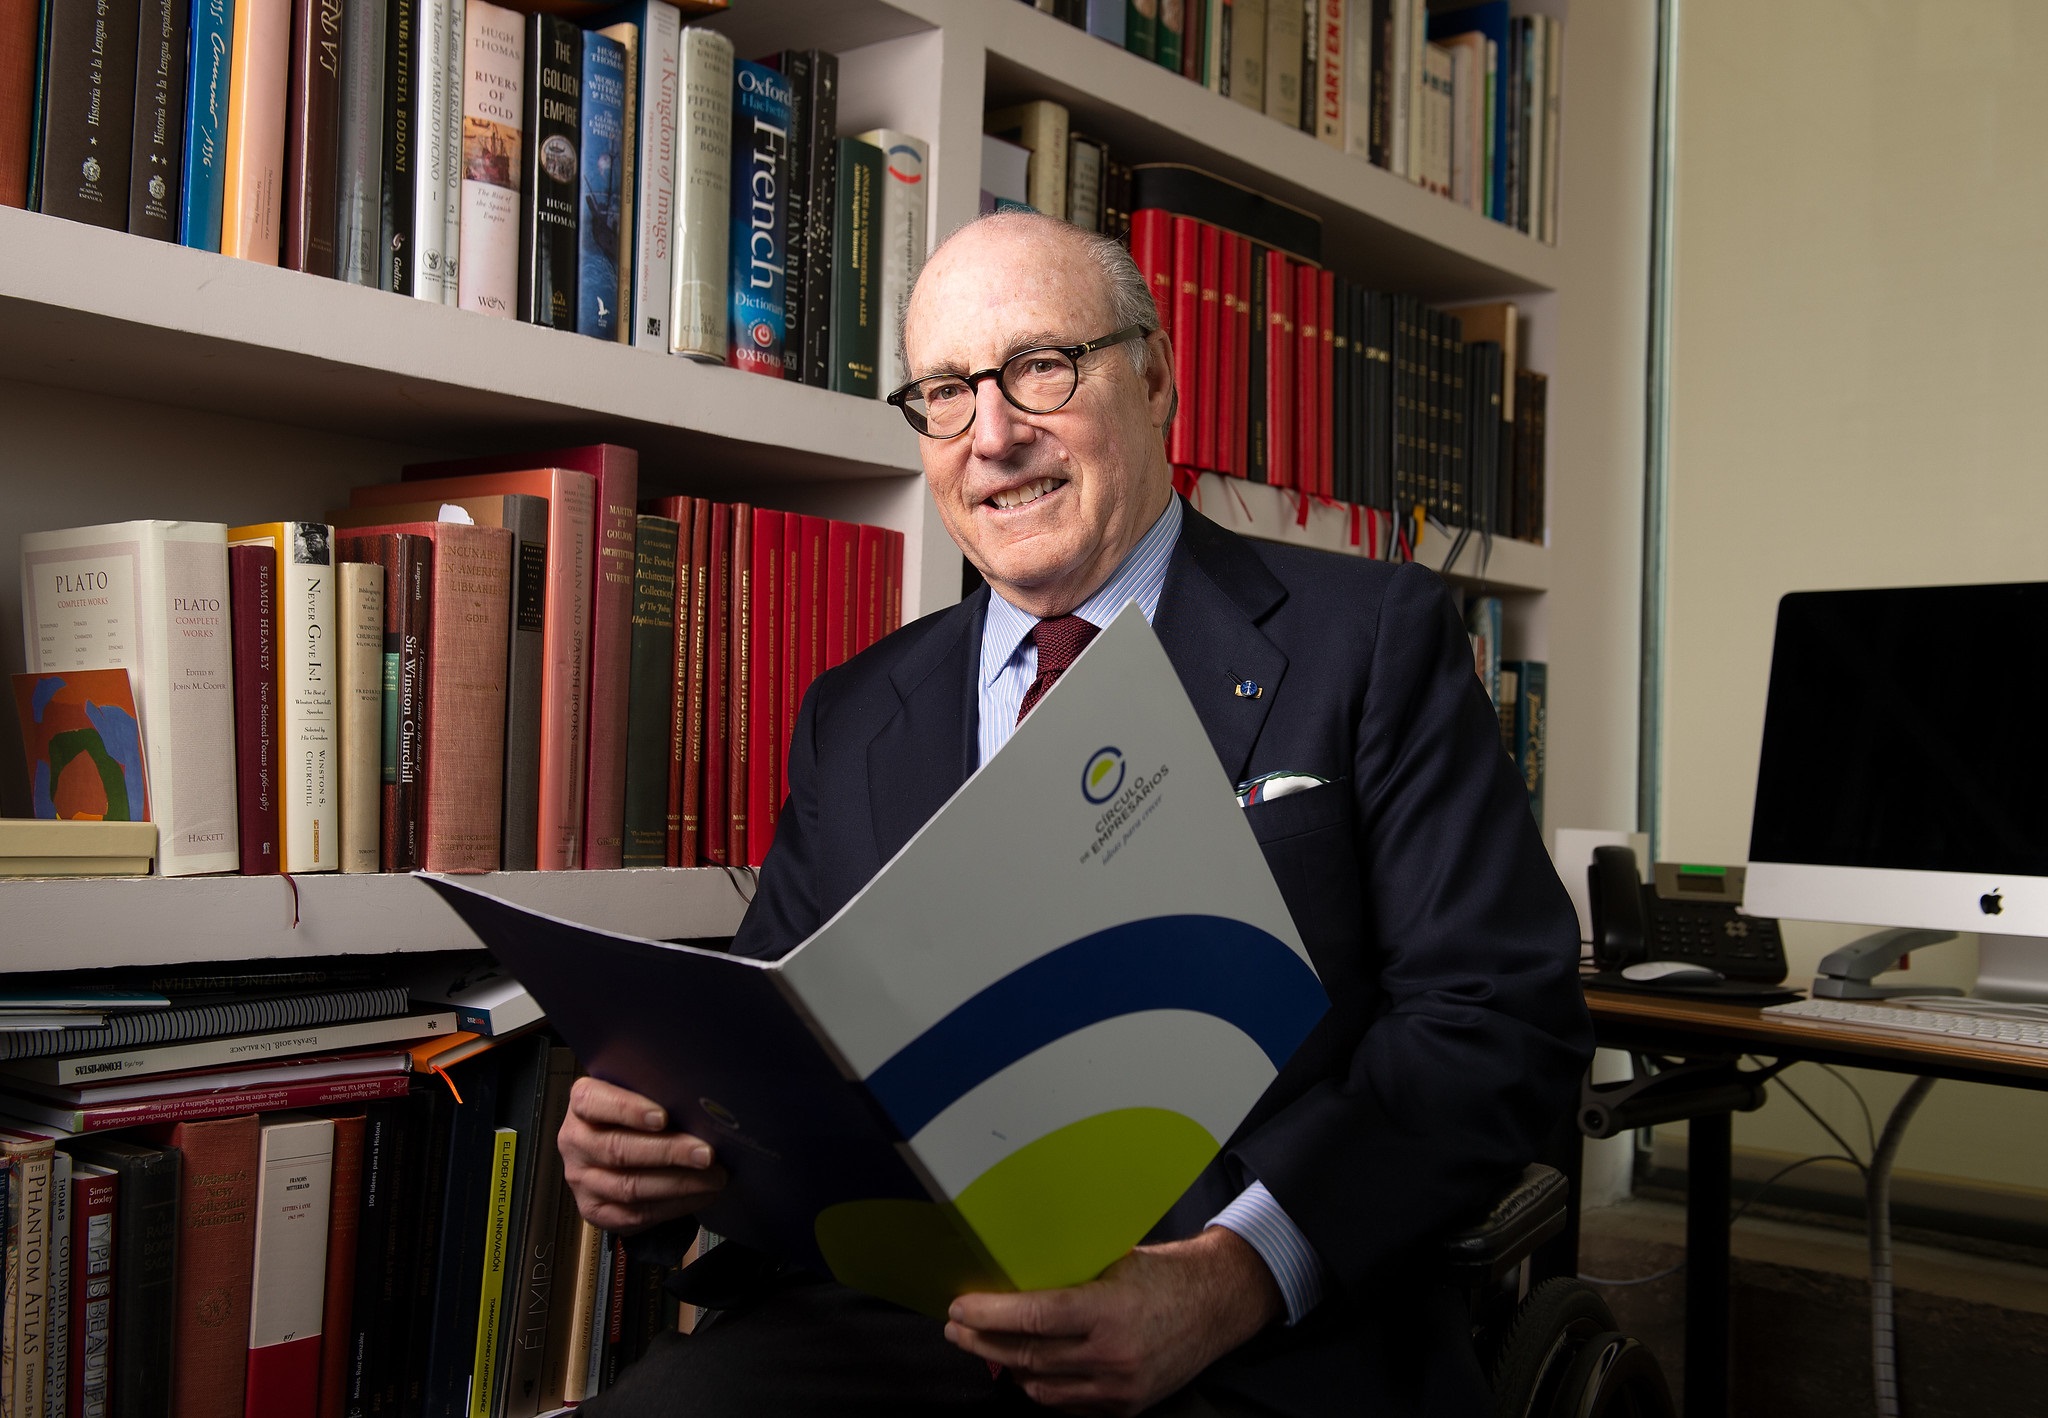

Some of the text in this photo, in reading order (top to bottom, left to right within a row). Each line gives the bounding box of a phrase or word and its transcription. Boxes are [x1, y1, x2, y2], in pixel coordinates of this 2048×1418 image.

[481, 25, 514, 44] HUGH
[320, 40, 337, 78] LA
[473, 38, 520, 61] THOMAS
[555, 40, 571, 65] THE
[88, 20, 107, 127] Historia de la Lengua
[475, 71, 518, 91] RIVERS
[543, 67, 579, 98] GOLDEN
[154, 42, 172, 146] Historia de la Lengua
[489, 89, 505, 103] OF
[738, 70, 793, 106] Oxford
[479, 104, 513, 120] GOLD
[543, 99, 577, 128] EMPIRE
[430, 69, 443, 181] MARSILIO FICINO
[448, 79, 460, 189] MARSILIO FICINO
[395, 109, 407, 172] BODONI
[653, 49, 676, 260] A Kingdom of Images
[80, 188, 103, 197] ACADEMIA
[146, 205, 167, 214] ACADEMIA
[546, 198, 572, 213] HUGH
[750, 116, 787, 290] French
[538, 211, 576, 228] THOMAS
[393, 257, 402, 291] Godine
[735, 292, 784, 318] Dictionary
[736, 348, 781, 367] OXFORD
[609, 504, 632, 517] MARTIN
[617, 519, 626, 528] ET
[607, 529, 632, 541] GOUJON
[575, 532, 584, 592] ITALIAN
[616, 561, 624, 570] DE
[639, 553, 653, 564] The
[56, 571, 108, 593] PLATO
[414, 562, 423, 600] Langworth
[451, 580, 503, 596] LIBRARIES
[58, 597, 108, 609] COMPLETE WORKS
[174, 598, 220, 612] PLATO
[573, 594, 583, 625] AND
[639, 603, 658, 612] of The
[175, 616, 219, 625] COMPLETE
[720, 617, 728, 627] LA
[183, 629, 214, 638] WORKS
[259, 565, 269, 766] SEAMUS HEANEY New Selected Poems
[572, 630, 582, 688] SPANISH
[674, 563, 690, 762] CATÁLOGO DE LA BIBLIOTECA DE ZULUETA
[690, 566, 707, 762] CATÁLOGO DE LA BIBLIOTECA DE ZULUETA
[741, 683, 749, 695] LA
[402, 635, 418, 783] Sir Winston Churchill
[570, 693, 580, 741] BOOKS
[1091, 763, 1169, 855] EMPRESARIOS
[153, 977, 233, 991] LEVIATHAN
[75, 1061, 122, 1075] ECONOMISTAS
[186, 1098, 214, 1109] legislativa
[215, 1096, 245, 1106] regulación
[351, 1089, 381, 1099] José Miguel
[184, 1106, 217, 1117] corporativa
[236, 1099, 279, 1112] responsabilidad
[102, 1116, 136, 1125] sociedades
[146, 1112, 171, 1122] Derecho
[30, 1164, 45, 1173] THE
[368, 1122, 382, 1208] 100 para Historia
[192, 1168, 247, 1187] Webster's
[57, 1178, 66, 1221] THOMAS
[89, 1186, 113, 1196] Simon
[89, 1194, 113, 1206] Loxley
[205, 1185, 234, 1198] New
[189, 1197, 247, 1215] Collegiate
[492, 1141, 511, 1272] EL LÍDER ANTE LA INNOVACIÓN
[186, 1212, 247, 1231] Dictionary
[87, 1213, 112, 1275] TYPE
[23, 1174, 47, 1356] PHANTOM ATLAS
[86, 1276, 111, 1299] IS
[518, 1242, 555, 1350] ÉLIXIRS
[612, 1246, 626, 1337] WORLD HISTORY
[56, 1236, 69, 1402] COLUMBIA BUSINESS
[283, 1331, 295, 1342] nrf
[482, 1298, 497, 1391] TOMMASO ANTONIO
[25, 1363, 35, 1404] EDWARD
[353, 1377, 361, 1399] Moisés
